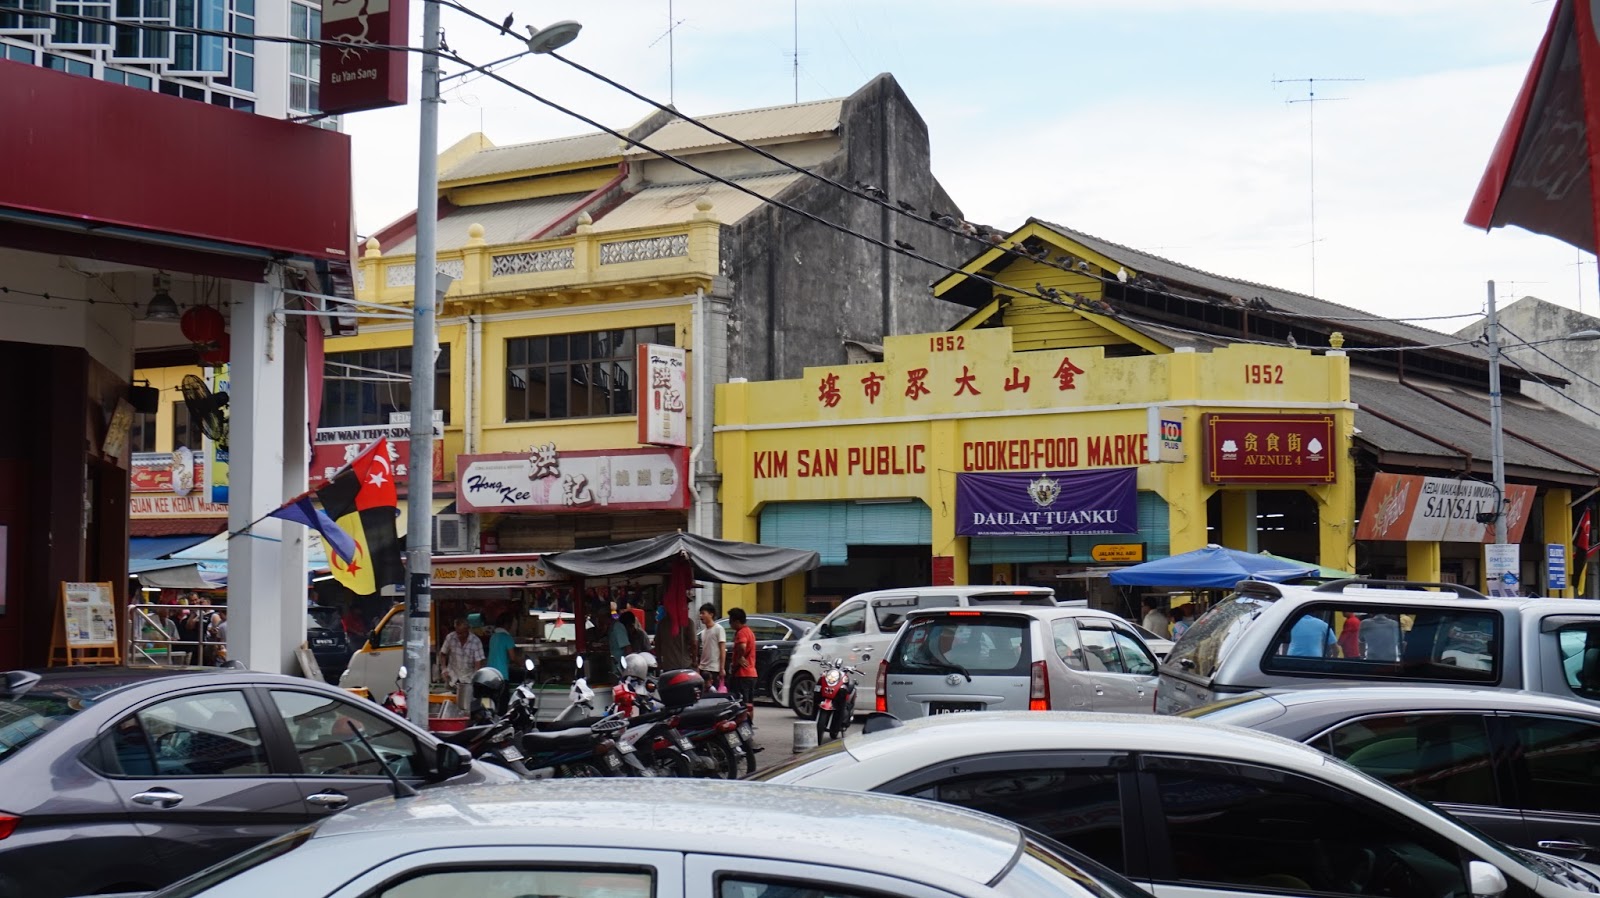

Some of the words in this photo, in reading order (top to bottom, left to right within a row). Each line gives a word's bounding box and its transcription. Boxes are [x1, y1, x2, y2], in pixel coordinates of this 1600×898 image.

[331, 72, 341, 83] Eu
[342, 71, 356, 81] Yan
[357, 68, 377, 80] Sang
[930, 335, 965, 352] 1952
[1245, 364, 1284, 385] 1952
[316, 432, 336, 442] IEW
[337, 430, 360, 440] WAN
[1163, 422, 1179, 441] 100
[1164, 441, 1179, 450] PLUS
[753, 450, 788, 479] KIM
[797, 448, 838, 477] SAN
[848, 444, 926, 476] PUBLIC
[1087, 433, 1150, 467] MARKE
[1244, 454, 1293, 466] AVENUE
[1294, 455, 1303, 466] 4
[467, 474, 502, 493] Hong
[1422, 482, 1440, 495] KEDAI
[1441, 483, 1467, 497] MAKANAN
[500, 486, 531, 504] Kee
[131, 498, 152, 513] GUAN
[154, 497, 170, 513] KEE
[171, 497, 195, 513] KEDAI
[1423, 496, 1485, 520] SANSAN
[973, 511, 1042, 526] DAULAT
[1044, 509, 1118, 525] TUANKU
